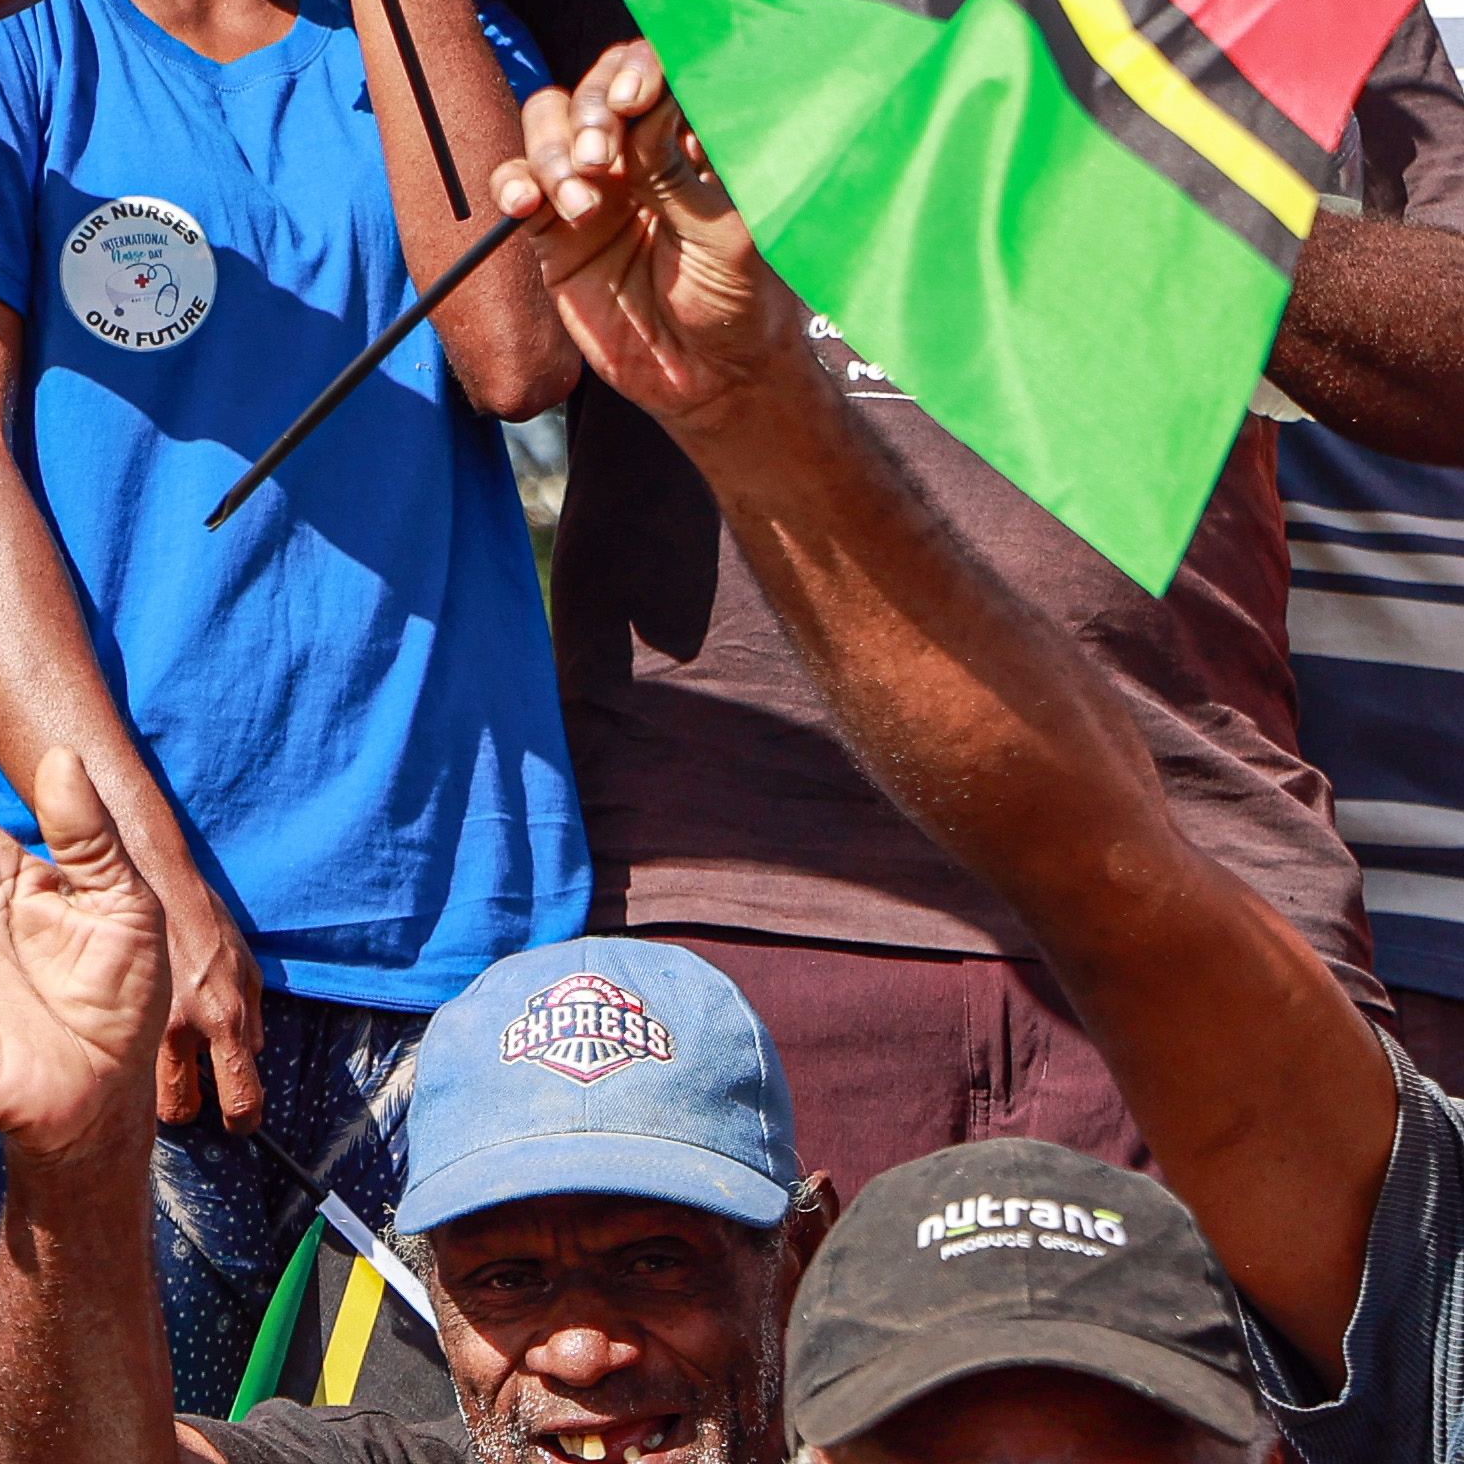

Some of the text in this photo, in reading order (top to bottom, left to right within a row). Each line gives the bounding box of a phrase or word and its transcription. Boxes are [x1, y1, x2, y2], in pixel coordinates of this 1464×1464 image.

[70, 203, 199, 255] OUR NURSES
[100, 233, 168, 252] INTERNATIONAL
[148, 249, 163, 259] DAY
[85, 295, 208, 347] OUR FUTURE
[506, 1003, 672, 1060] EXPRESS
[939, 1230, 1108, 1262] PRODUCE GROUP
